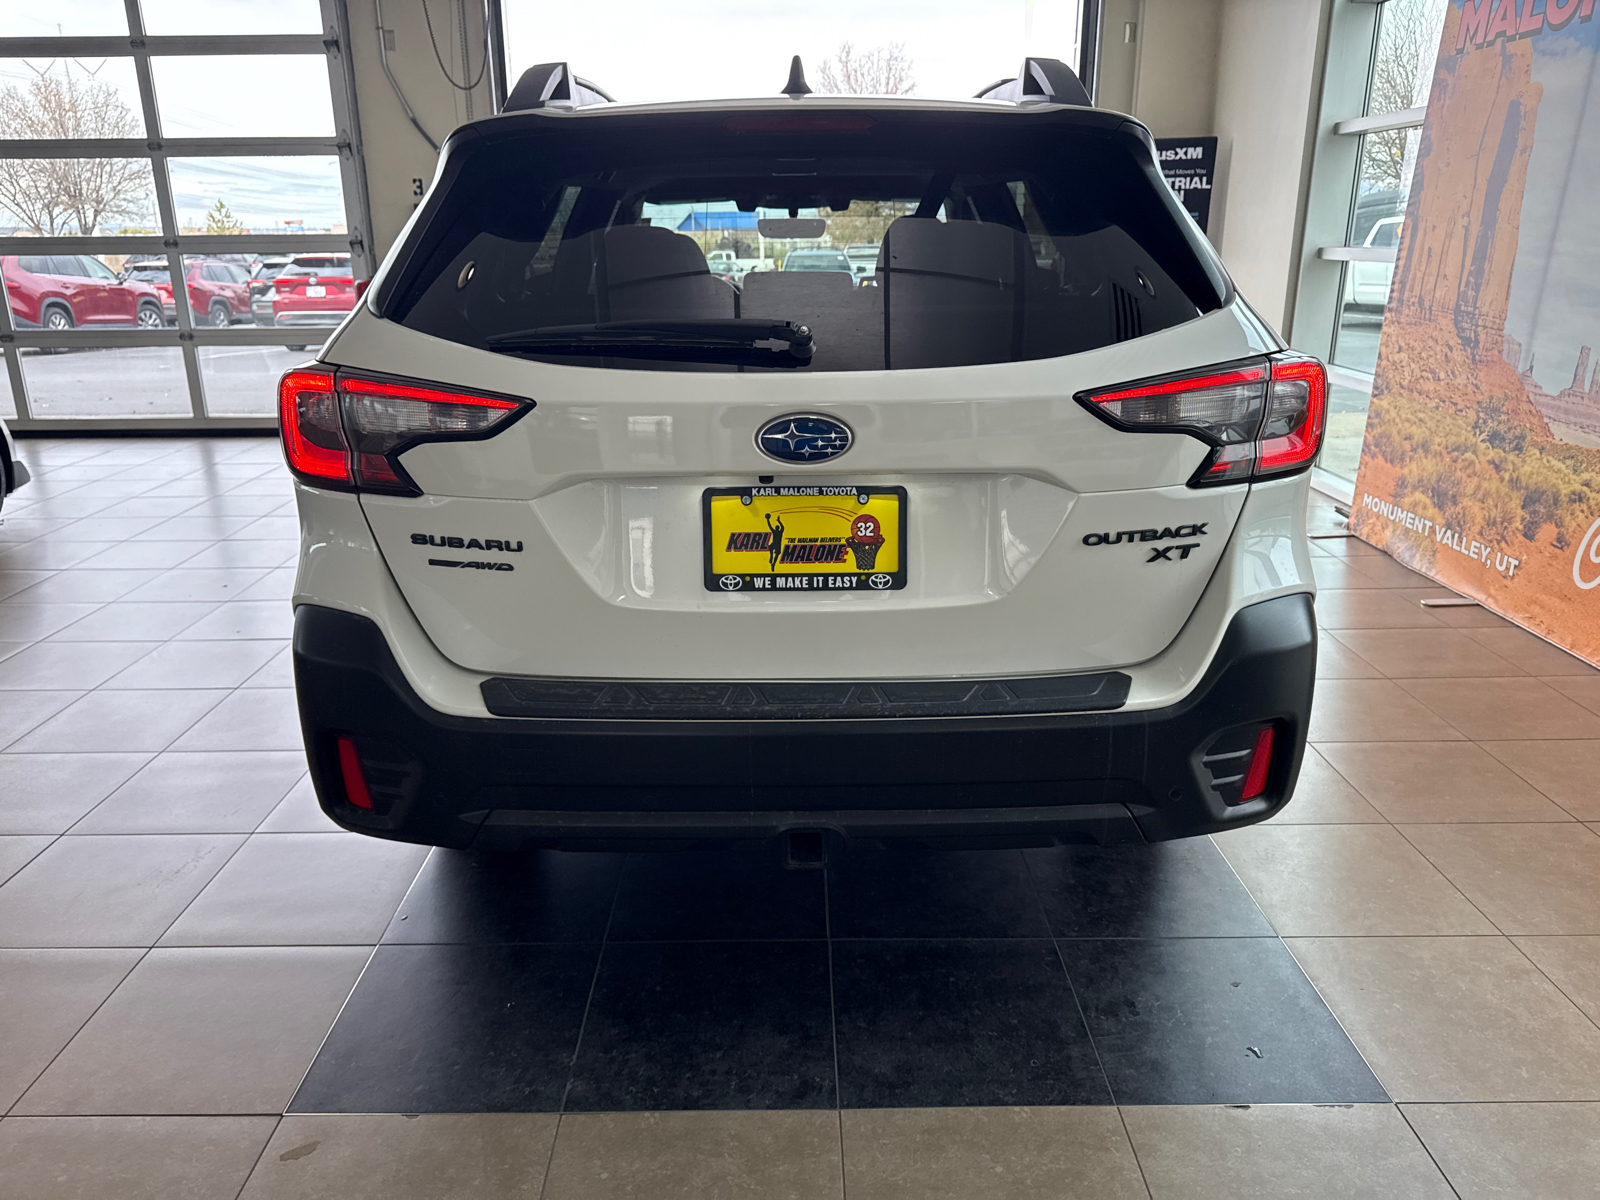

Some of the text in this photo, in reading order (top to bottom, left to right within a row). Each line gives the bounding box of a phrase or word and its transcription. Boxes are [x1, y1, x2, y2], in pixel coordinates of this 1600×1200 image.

[1157, 147, 1203, 160] usXM
[412, 178, 423, 196] 3
[1165, 176, 1211, 190] TRIAL
[752, 486, 858, 496] KARL MALONE TOYOTA
[856, 522, 875, 537] 32
[1082, 522, 1209, 546] OUTBACK
[1362, 492, 1519, 577] MONUMENT VALLEY, UT
[410, 533, 523, 552] SUBARU
[725, 532, 772, 552] KARL
[779, 544, 849, 563] MALONE
[1146, 543, 1200, 562] XT
[460, 561, 514, 571] AWD
[754, 576, 858, 588] WE MAKE IT EASY
